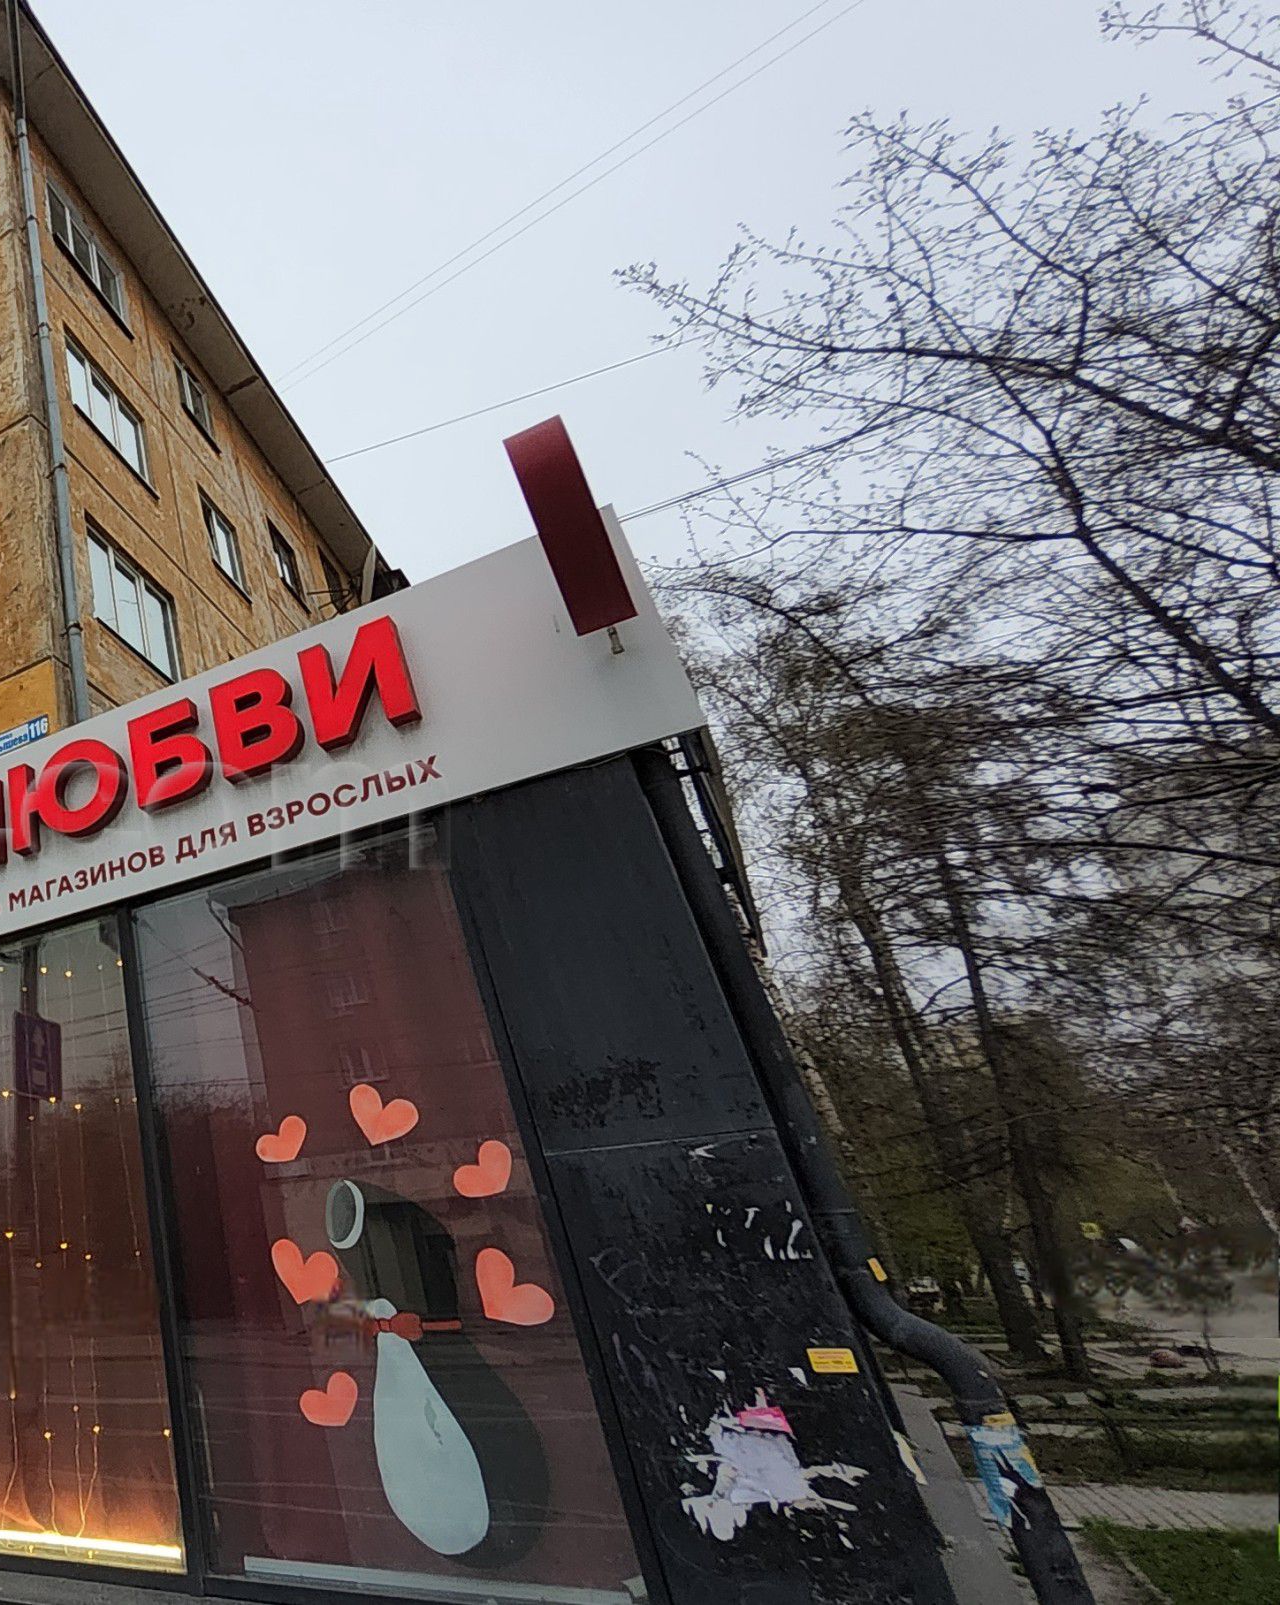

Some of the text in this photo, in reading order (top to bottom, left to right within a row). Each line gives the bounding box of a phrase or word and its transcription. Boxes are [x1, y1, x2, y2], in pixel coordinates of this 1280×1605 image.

[28, 717, 49, 738] 116
[8, 845, 167, 912] МАГАЗИНОВ
[176, 820, 238, 864] ДЛЯ
[248, 755, 443, 839] ВЗРОСЛЫХ
